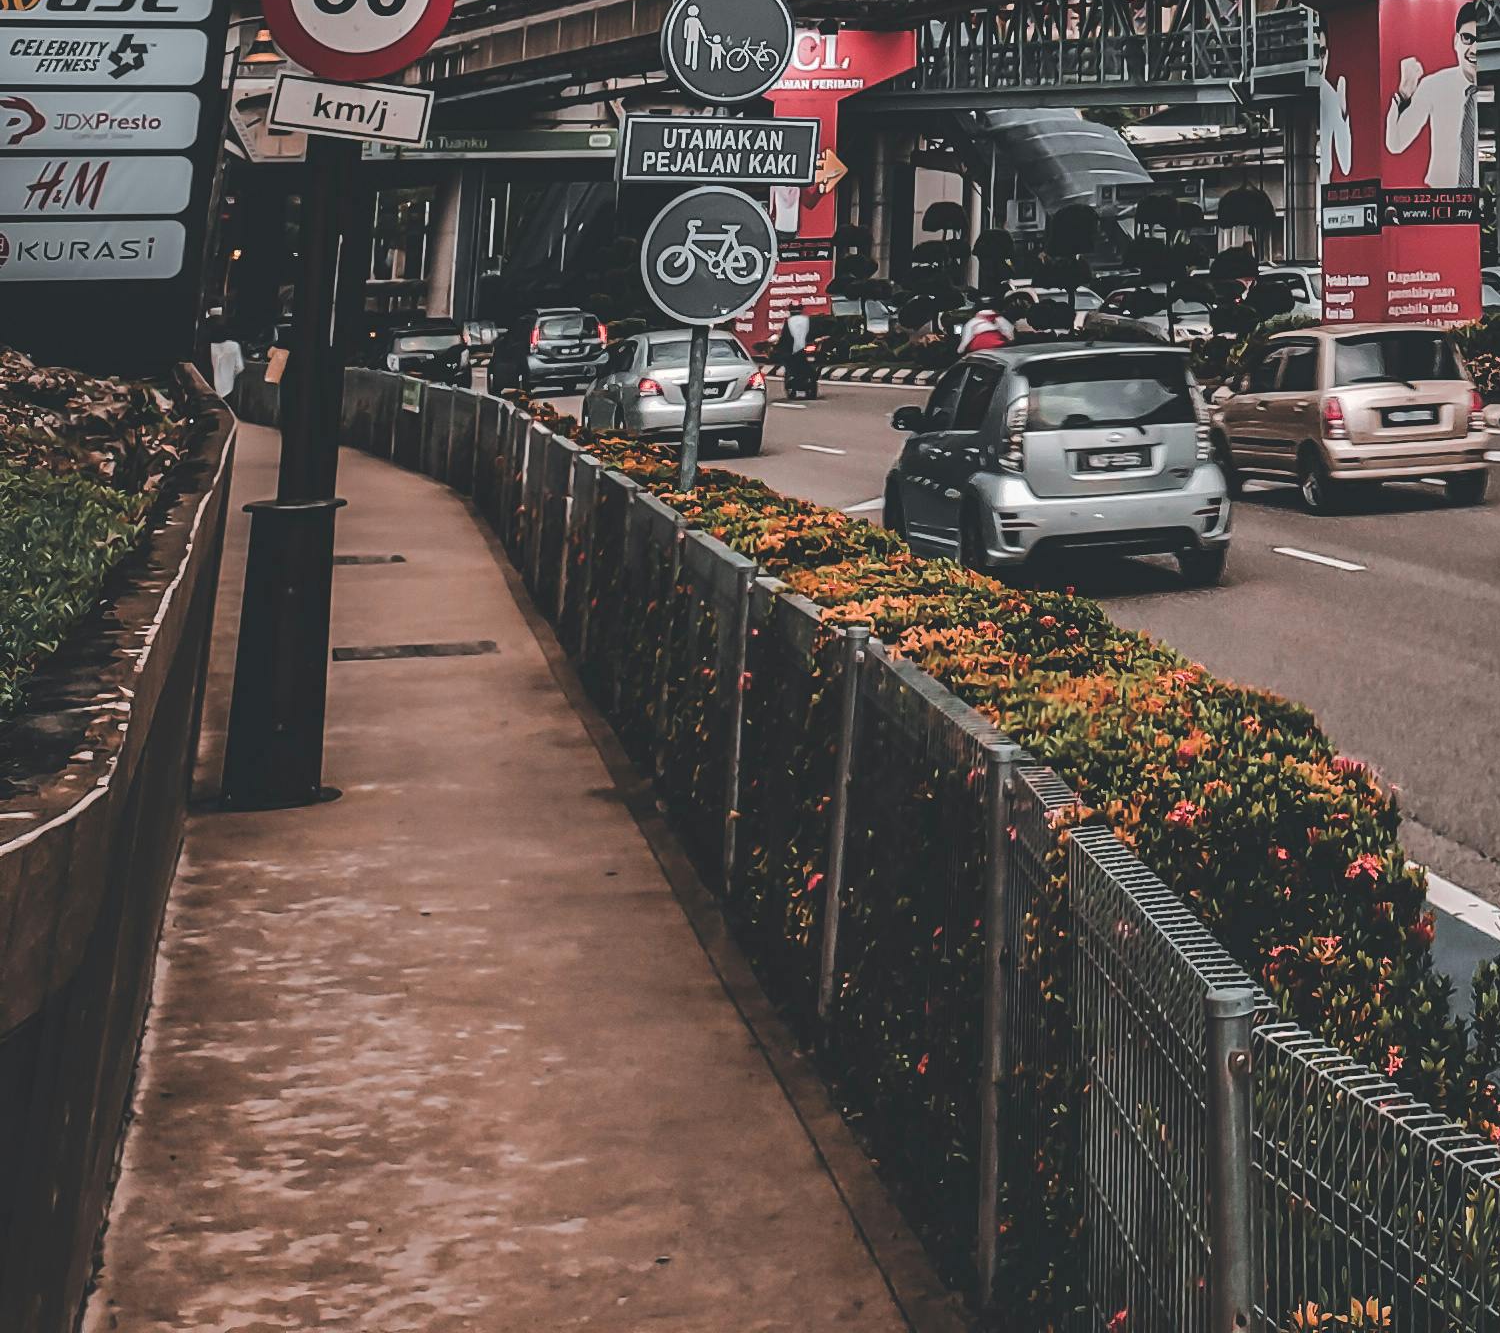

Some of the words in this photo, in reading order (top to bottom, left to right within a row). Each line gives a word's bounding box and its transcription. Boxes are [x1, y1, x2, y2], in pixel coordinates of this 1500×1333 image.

[9, 38, 110, 57] CELEBRITY
[792, 32, 850, 71] CL
[35, 58, 101, 73] FITNESS
[811, 78, 864, 90] PERIBADI
[53, 112, 161, 130] JDXPresto
[312, 93, 390, 132] km/j
[663, 128, 784, 151] UTAMAKAN
[642, 151, 742, 175] PEJALAN
[749, 152, 798, 176] KAKI
[24, 161, 111, 211] H&M
